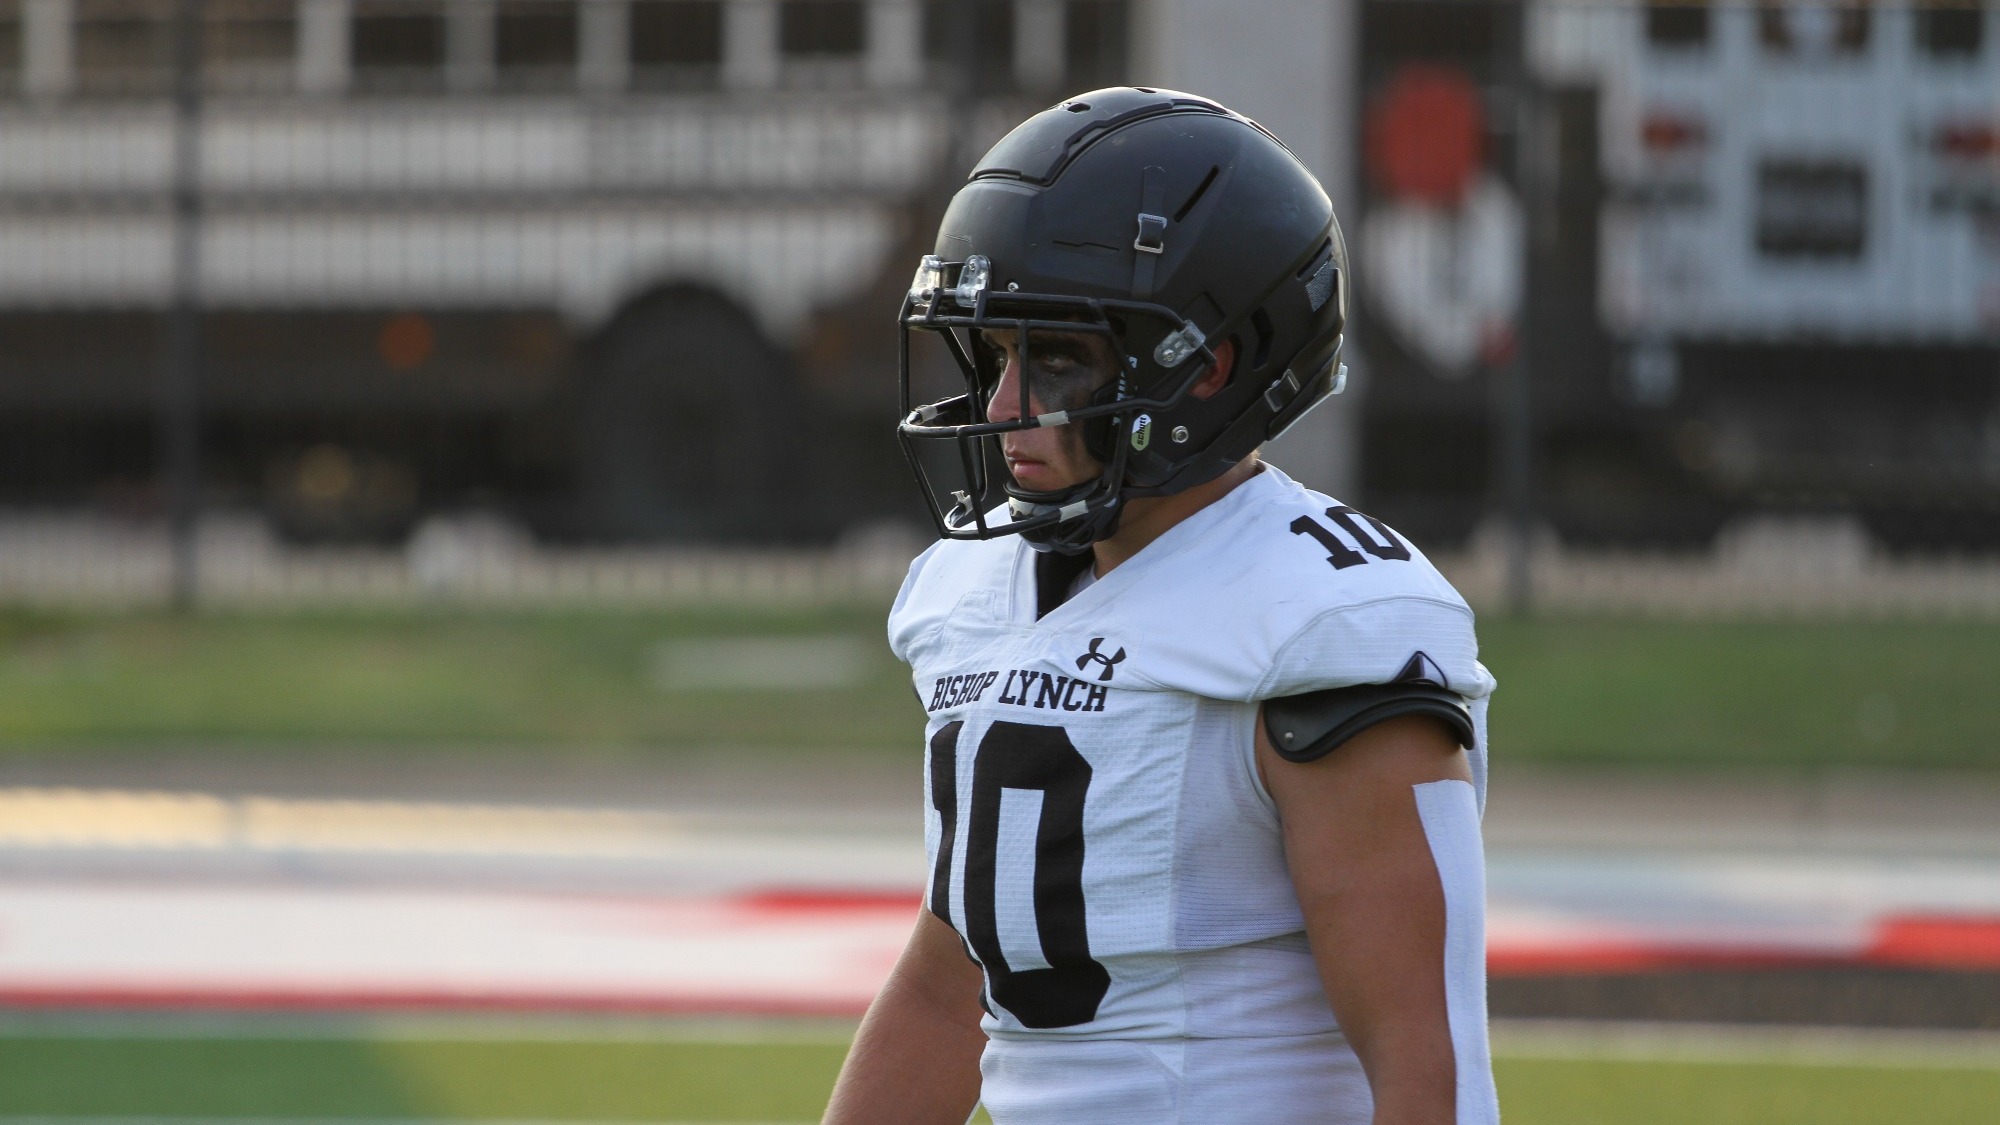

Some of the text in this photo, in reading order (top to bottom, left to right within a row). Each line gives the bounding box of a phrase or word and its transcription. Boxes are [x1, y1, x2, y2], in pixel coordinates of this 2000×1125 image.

[1290, 505, 1412, 570] 10
[928, 670, 1107, 712] BISHOP LYNCH
[930, 720, 1111, 1029] 10
